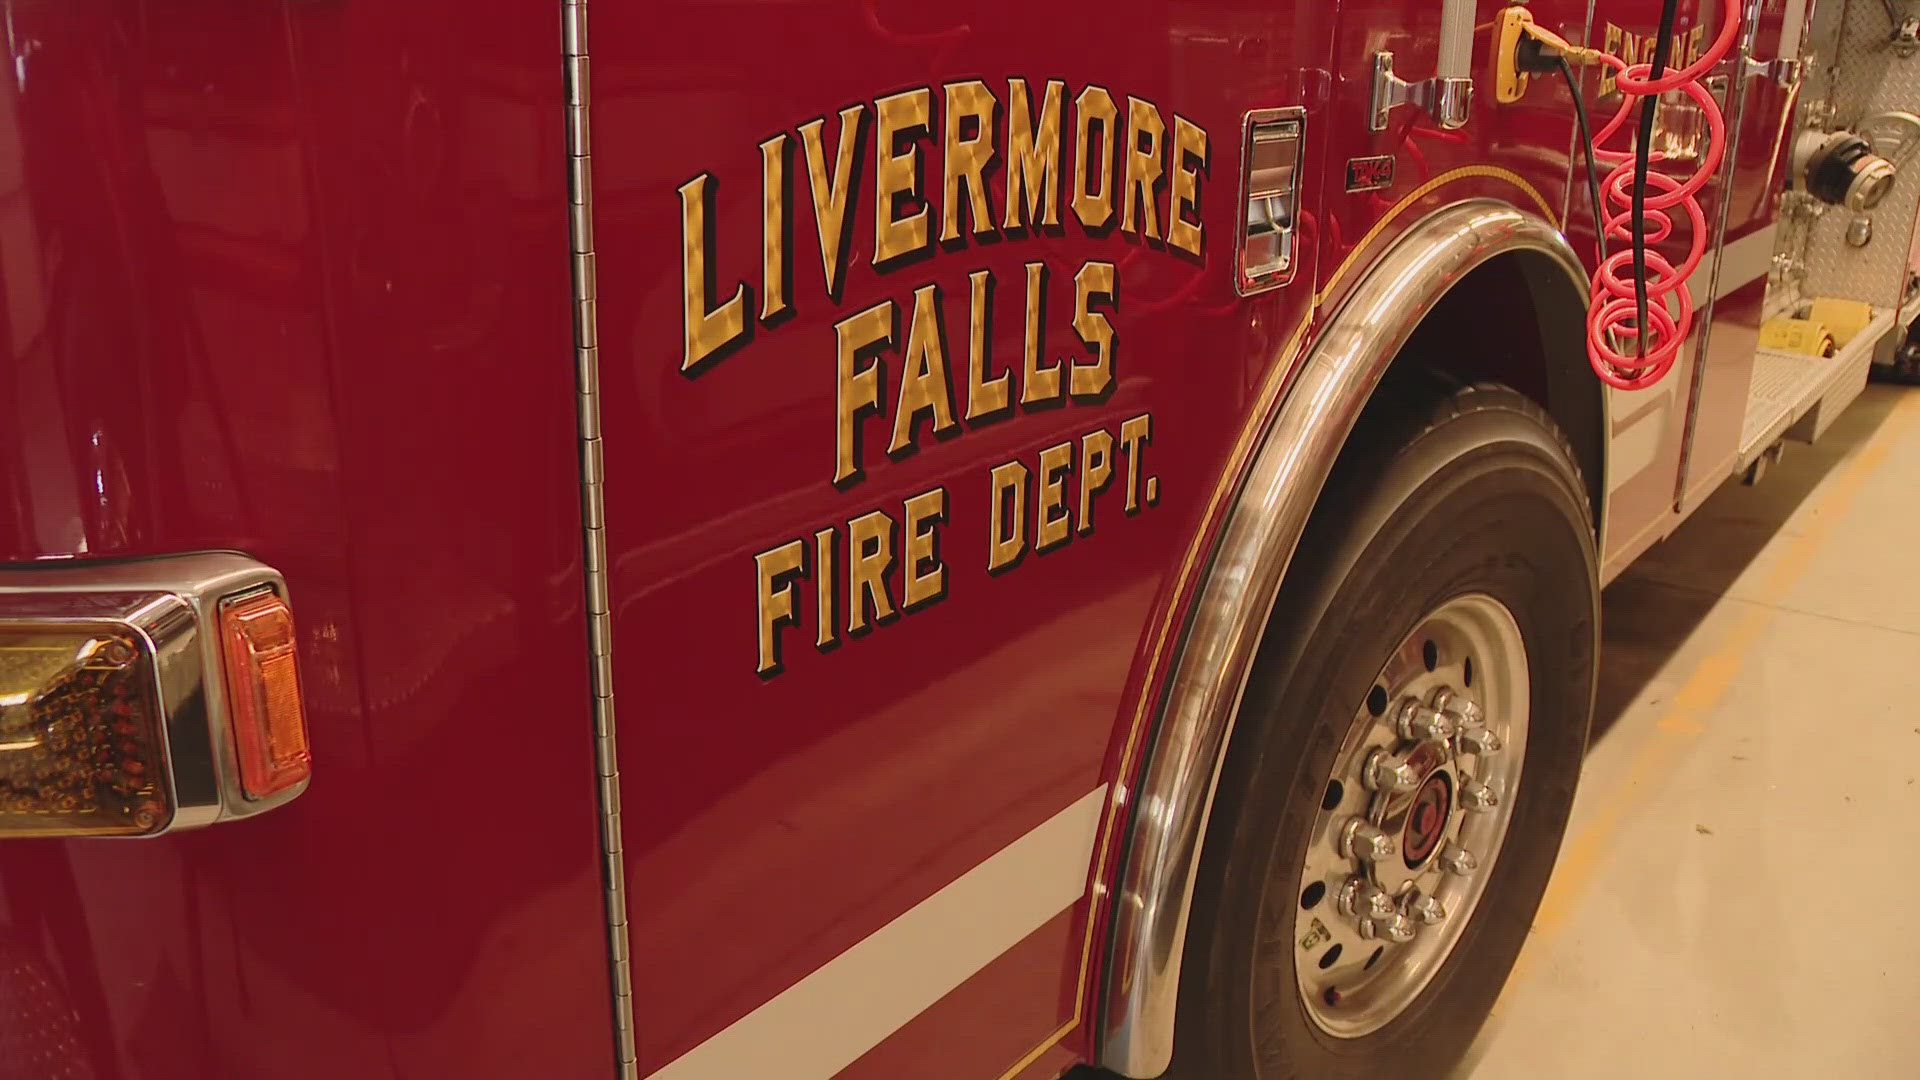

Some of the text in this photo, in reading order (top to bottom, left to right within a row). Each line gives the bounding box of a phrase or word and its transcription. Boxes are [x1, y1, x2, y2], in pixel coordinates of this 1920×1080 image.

[1598, 22, 1704, 98] ENGNE
[678, 77, 1209, 374] LIVERMORE
[833, 261, 1118, 487] FALLS
[754, 413, 1159, 675] FIRE DEPT.
